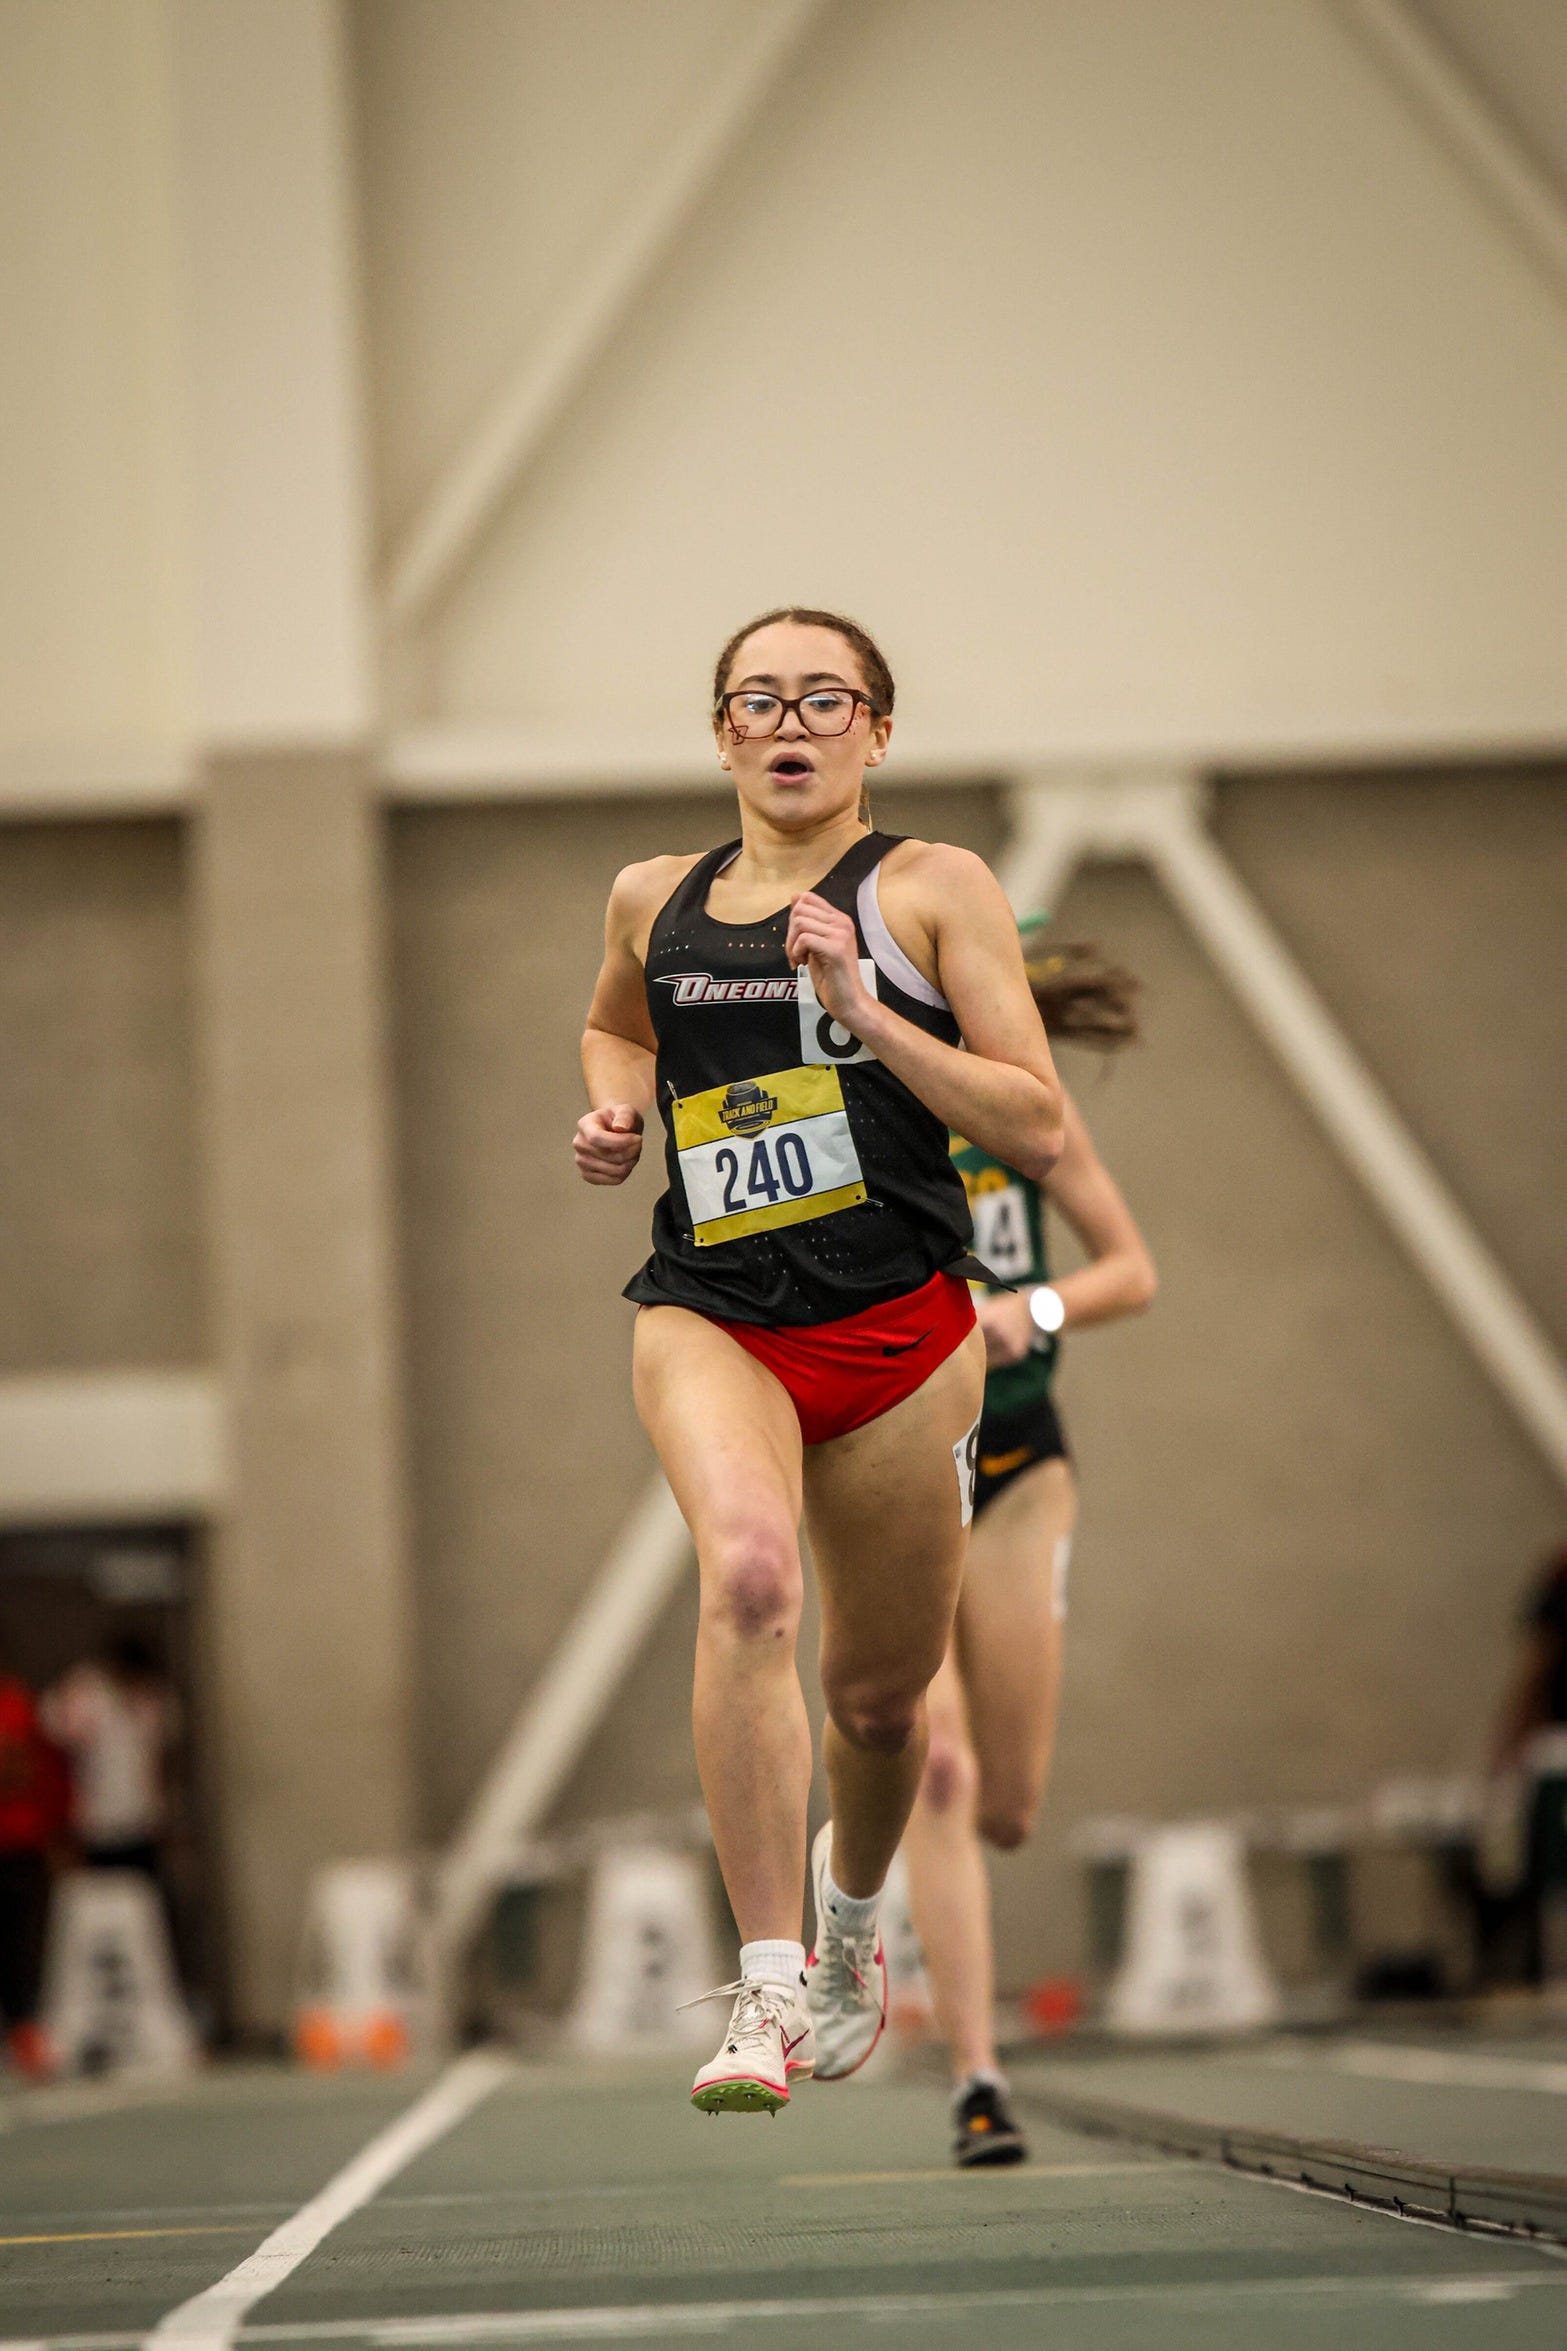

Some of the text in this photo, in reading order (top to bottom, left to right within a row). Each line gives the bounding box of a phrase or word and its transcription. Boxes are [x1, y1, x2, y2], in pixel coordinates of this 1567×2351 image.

[722, 1108, 740, 1122] TRACK
[741, 1103, 756, 1117] AND
[756, 1099, 774, 1113] FIELD
[715, 1132, 814, 1213] 240
[988, 1203, 1018, 1263] 4
